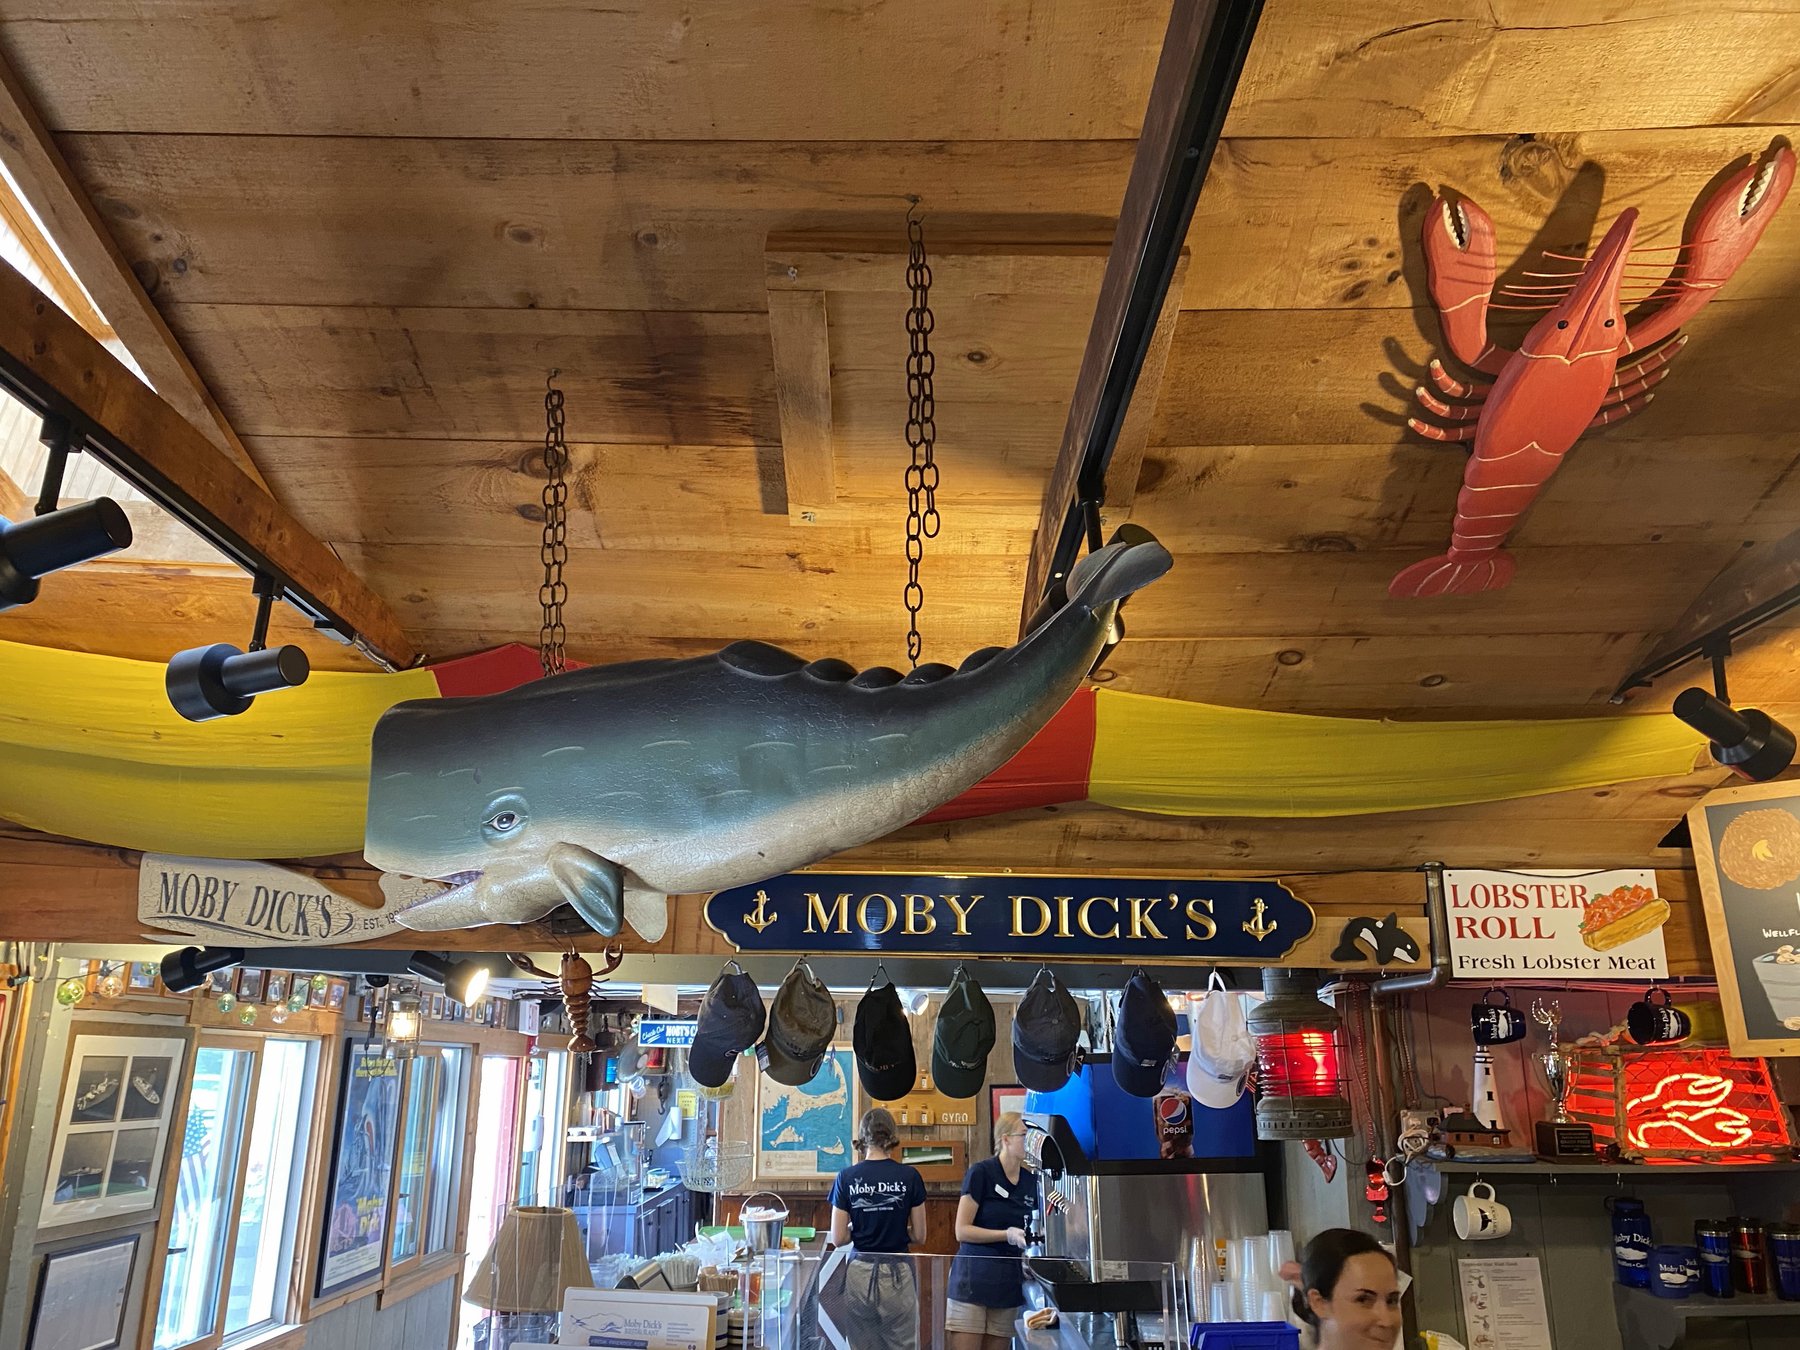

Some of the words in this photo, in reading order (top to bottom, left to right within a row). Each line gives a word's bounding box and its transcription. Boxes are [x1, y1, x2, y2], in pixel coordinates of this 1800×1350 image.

[1451, 883, 1593, 909] LOBSTER
[158, 872, 239, 923] MOBY
[246, 885, 332, 939] DICK'S
[802, 892, 985, 936] MOBY
[1008, 893, 1218, 940] DICK'S
[363, 917, 385, 931] EST.
[1455, 916, 1556, 940] ROLL
[1458, 954, 1515, 970] Fresh
[1522, 954, 1601, 970] Lobster
[1607, 955, 1656, 970] Meat
[941, 1112, 969, 1123] GYRO
[1163, 1125, 1188, 1135] pepsi
[849, 1183, 876, 1196] Moby
[878, 1181, 907, 1193] Dick's
[1659, 1264, 1679, 1272] Moby
[624, 1318, 642, 1329] Moby
[642, 1320, 663, 1330] Dick's
